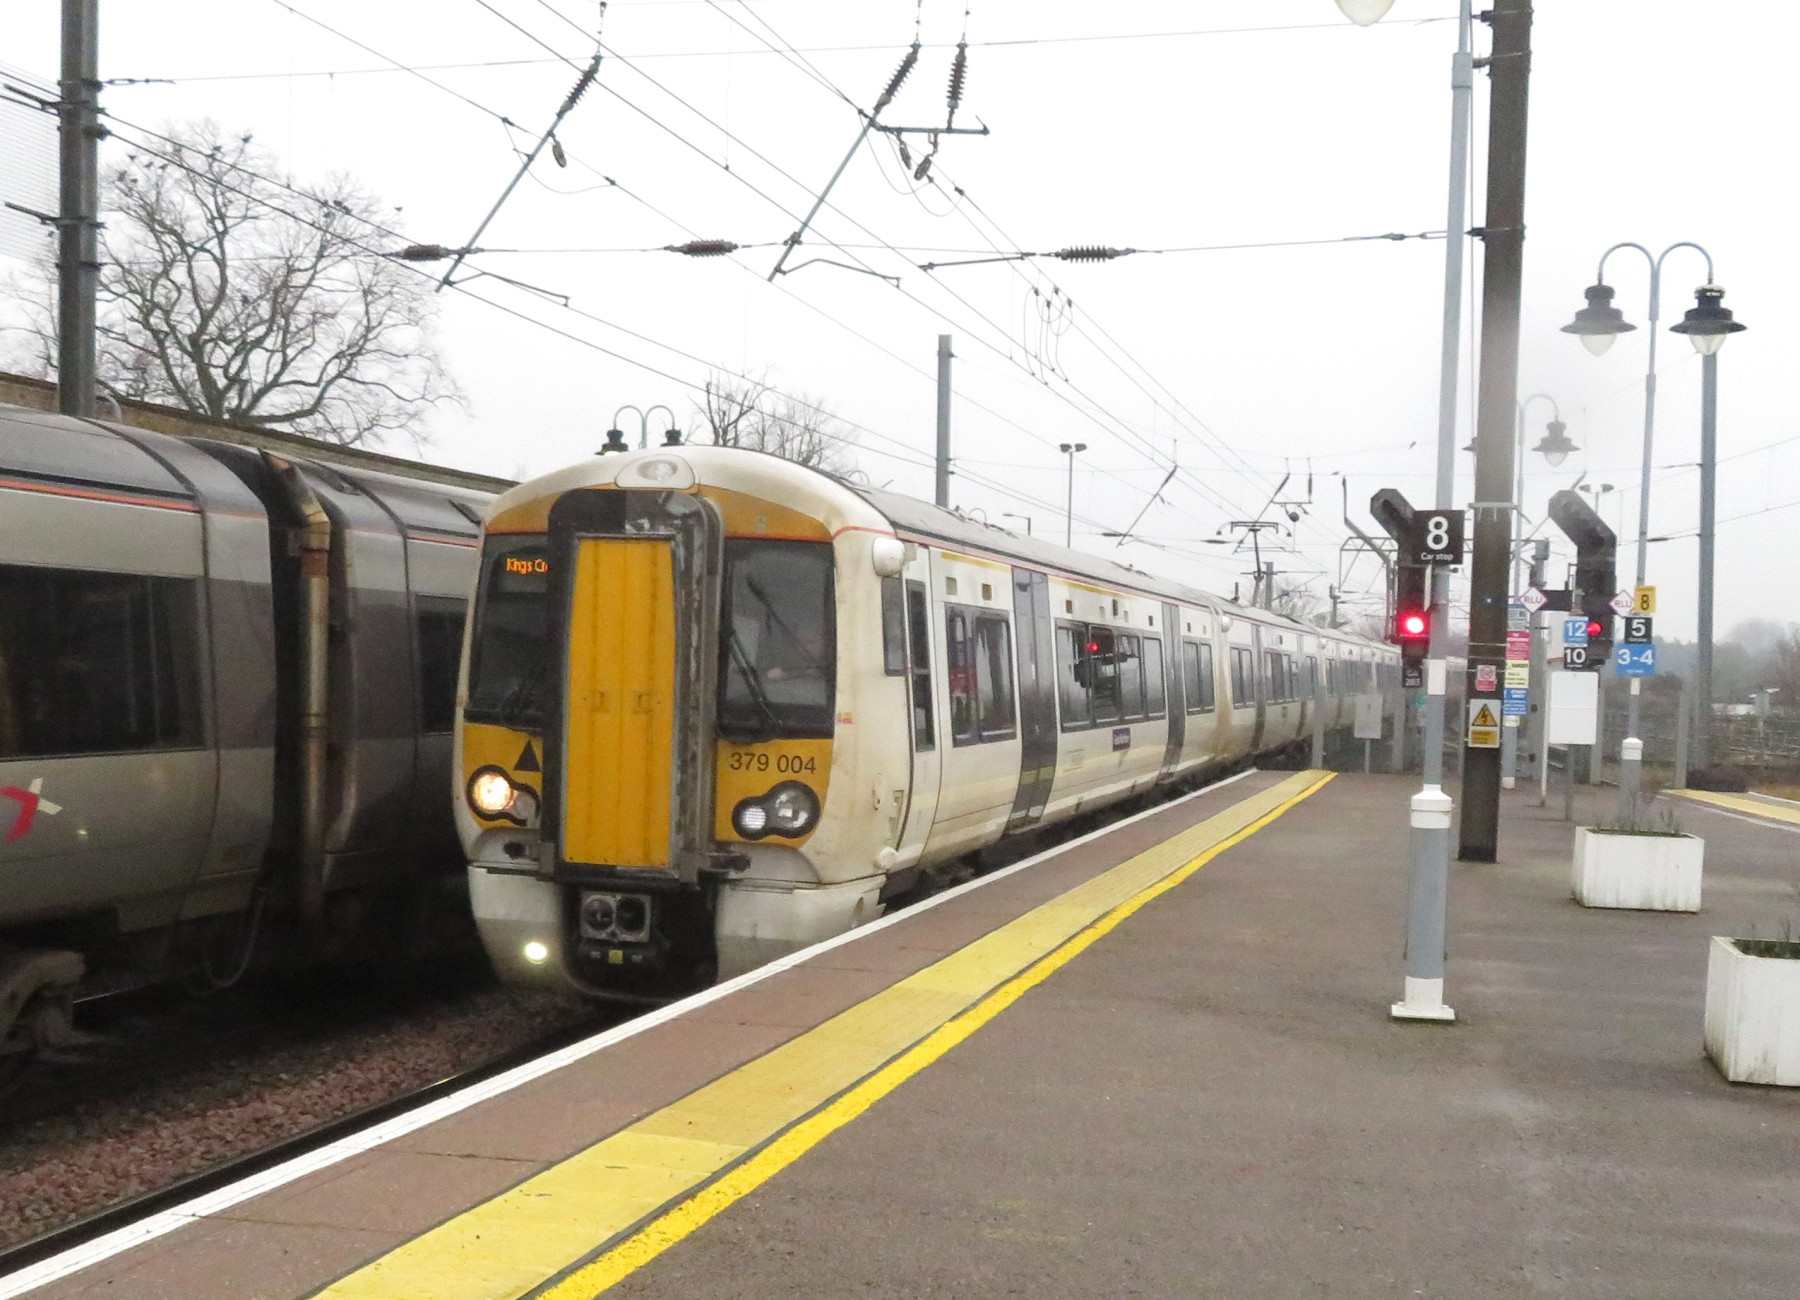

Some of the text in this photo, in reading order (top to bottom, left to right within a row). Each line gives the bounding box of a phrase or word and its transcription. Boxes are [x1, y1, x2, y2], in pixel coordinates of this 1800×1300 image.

[1426, 515, 1449, 550] 8
[506, 557, 532, 575] Kings
[1420, 552, 1454, 562] Car stop
[1640, 593, 1650, 611] 8
[1566, 621, 1587, 637] 12
[1631, 618, 1646, 637] 5
[1564, 648, 1587, 664] 10
[1617, 648, 1654, 666] 3-4
[729, 751, 817, 775] 379 004
